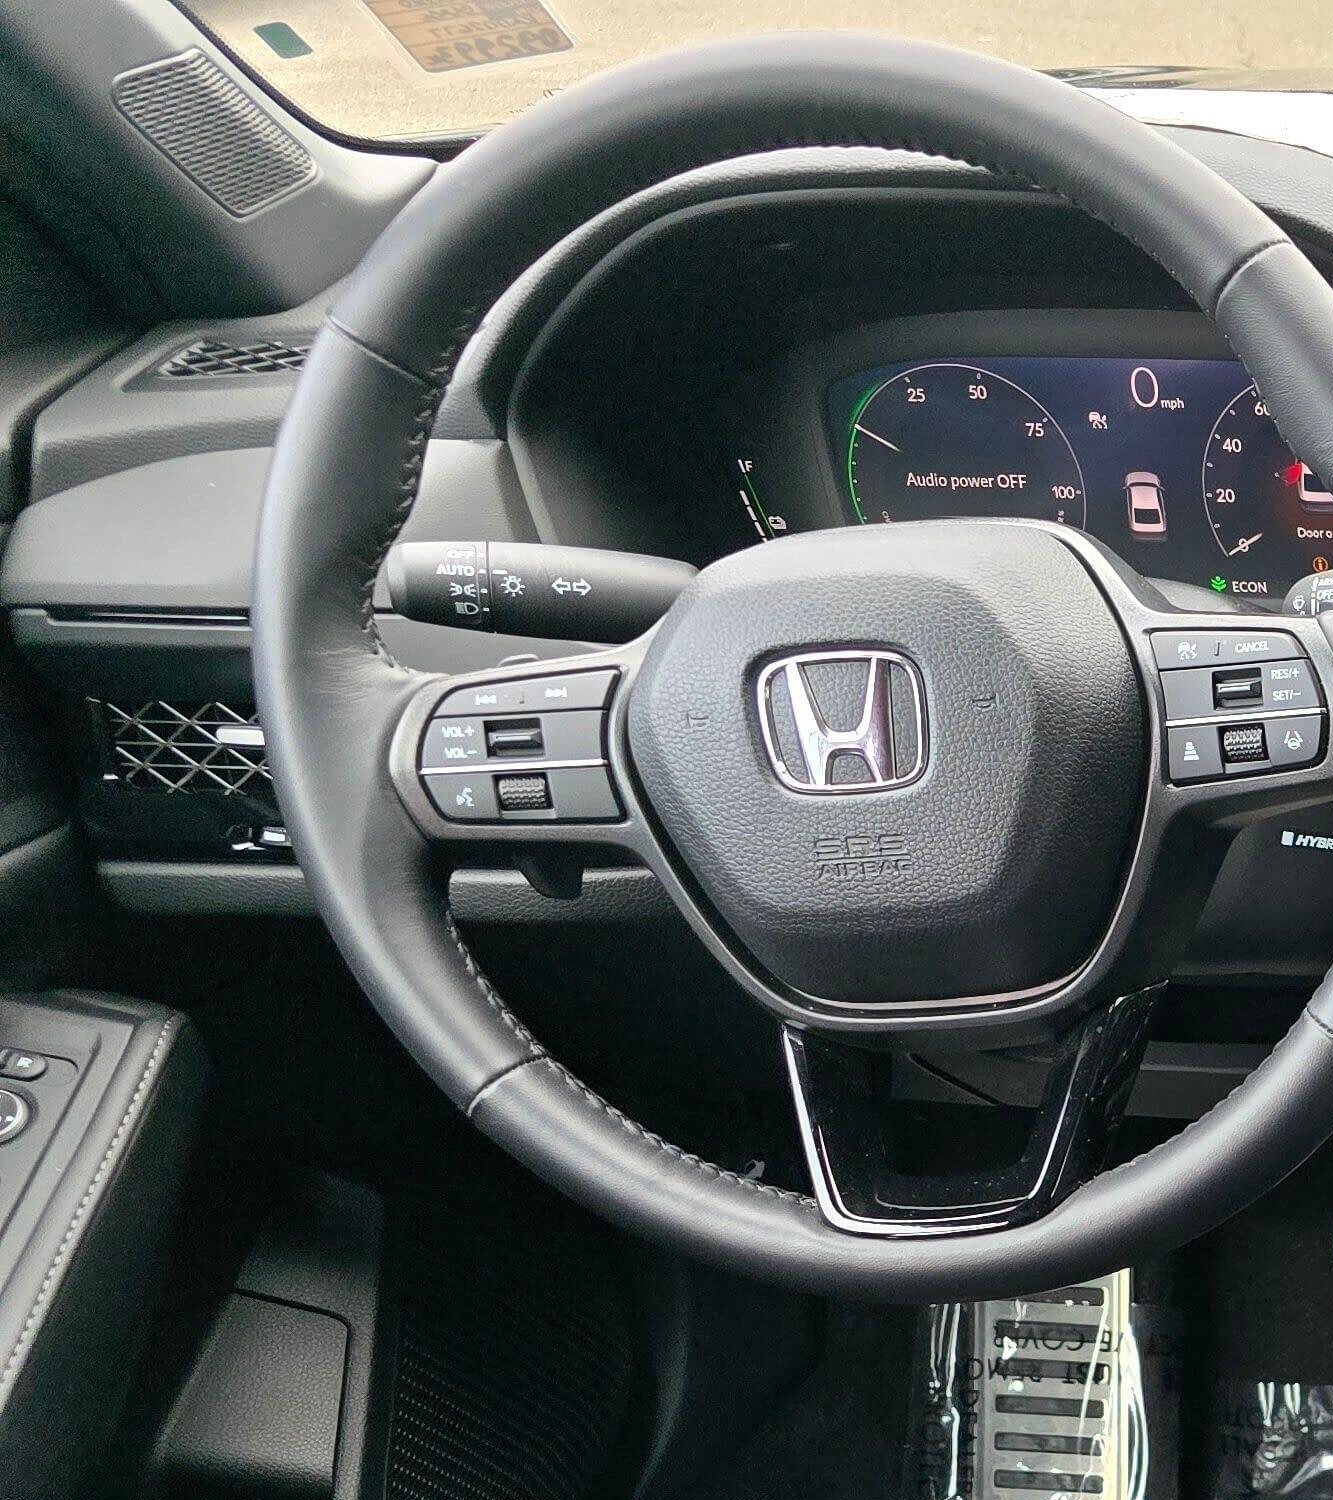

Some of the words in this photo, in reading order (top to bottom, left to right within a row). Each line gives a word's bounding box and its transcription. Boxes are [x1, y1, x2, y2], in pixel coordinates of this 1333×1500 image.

[968, 384, 987, 400] 50
[1130, 366, 1159, 408] 0
[906, 388, 926, 402] 25
[1160, 398, 1185, 411] mph
[1025, 422, 1045, 438] 75
[1222, 438, 1242, 452] 40
[744, 460, 753, 472] F
[906, 472, 948, 488] Audio
[950, 475, 994, 491] power
[997, 474, 1027, 489] OFF
[1051, 485, 1076, 499] 100
[1216, 488, 1236, 503] 20
[1296, 527, 1324, 539] Door
[436, 563, 475, 577] AUTO
[1232, 581, 1268, 594] ECON
[1235, 640, 1270, 653] CANCEL
[813, 834, 907, 858] SRS
[818, 858, 914, 880] AIRBAG
